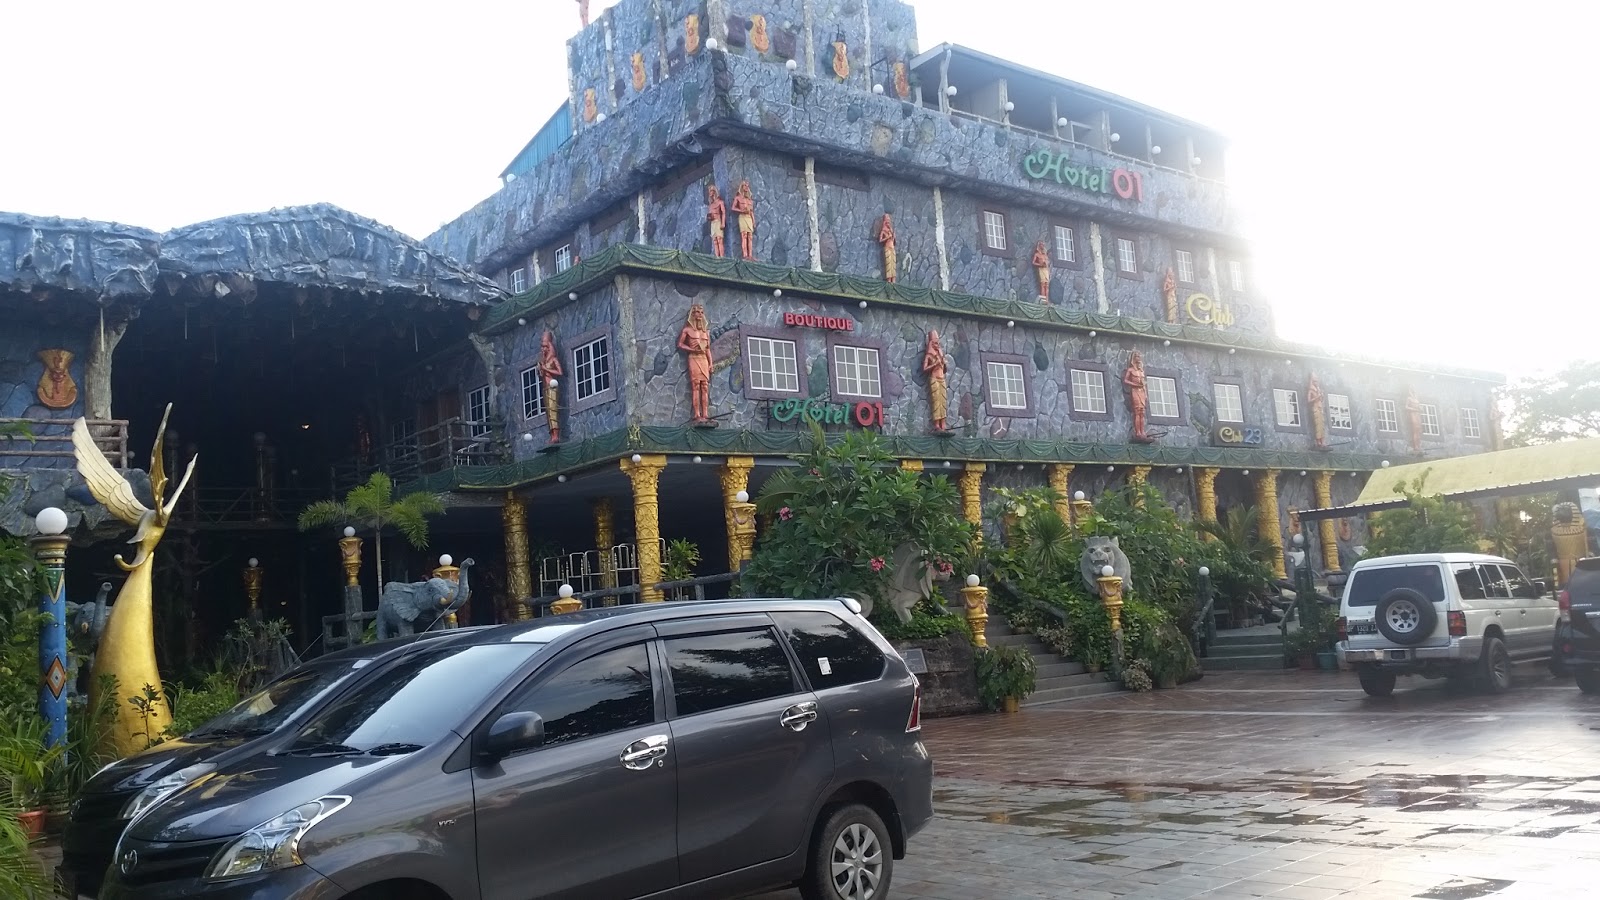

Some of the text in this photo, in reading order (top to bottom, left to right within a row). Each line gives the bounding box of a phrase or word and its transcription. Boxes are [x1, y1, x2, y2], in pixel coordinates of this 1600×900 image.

[1024, 150, 1143, 203] Hotel 01
[785, 313, 854, 331] BOUTIQUE
[1186, 293, 1234, 327] Club
[772, 398, 884, 427] Hotel 01
[1219, 426, 1262, 444] Club 23
